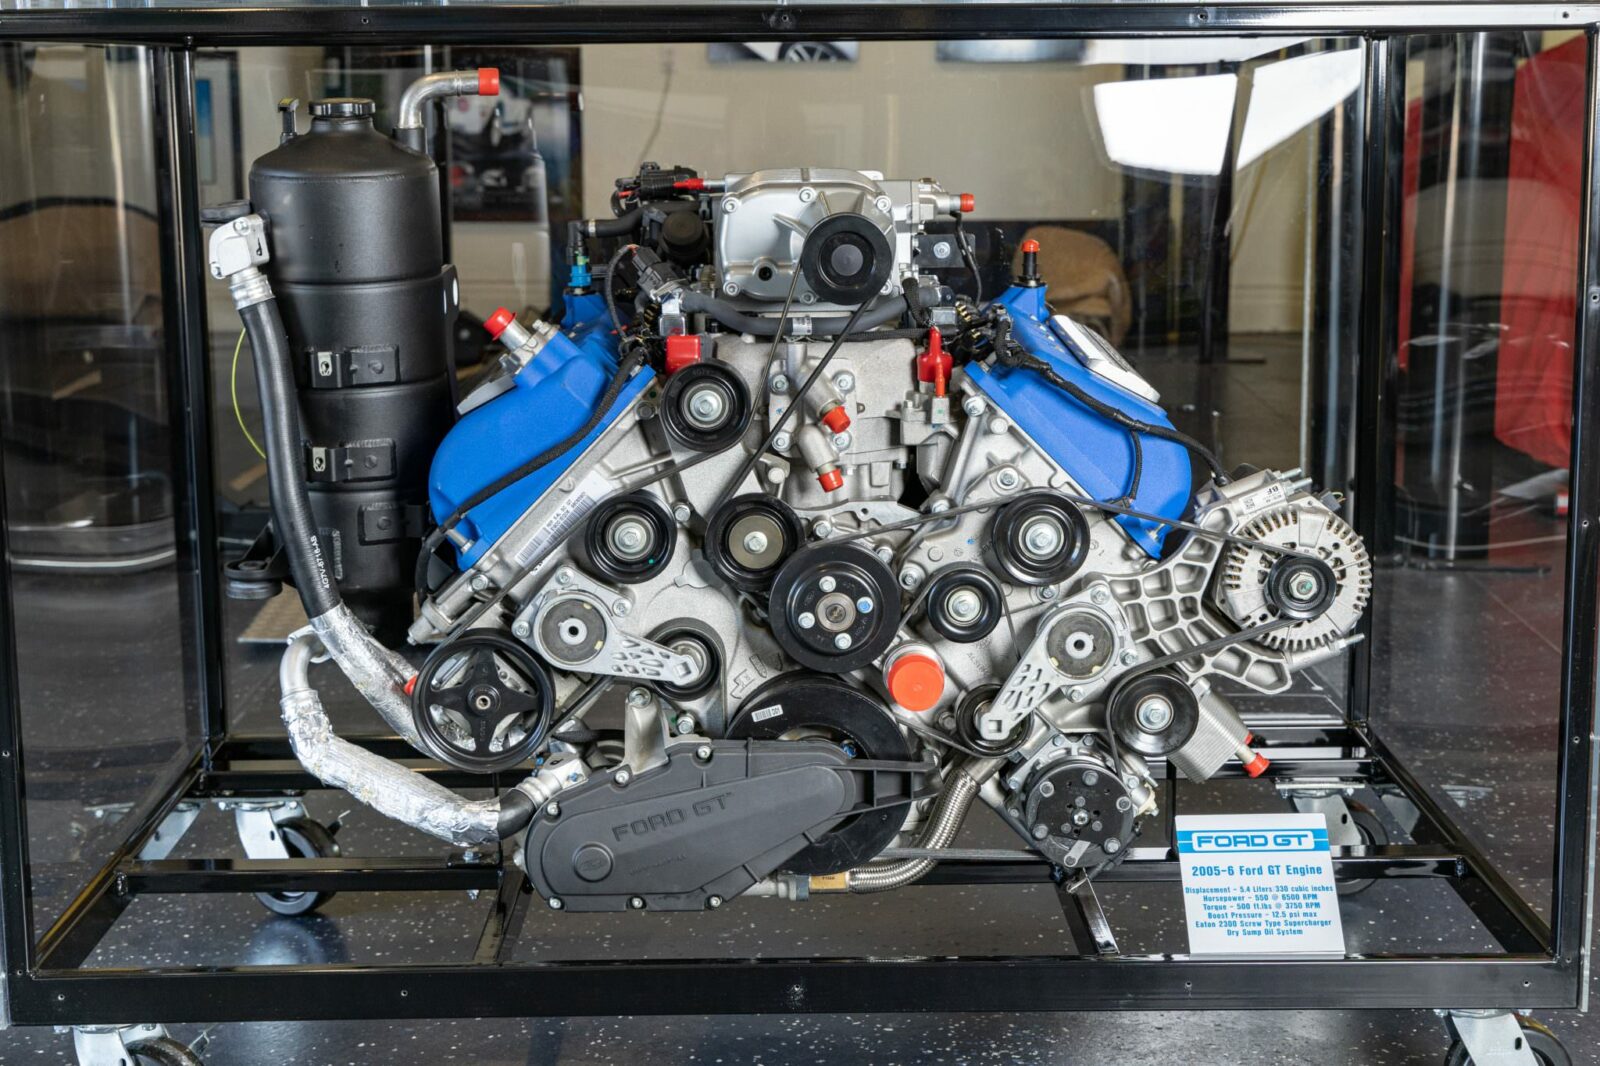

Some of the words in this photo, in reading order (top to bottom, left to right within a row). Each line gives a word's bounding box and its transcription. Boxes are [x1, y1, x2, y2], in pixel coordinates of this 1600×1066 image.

[612, 808, 685, 842] FORD
[1196, 834, 1269, 848] FORD
[1273, 834, 1309, 846] GT
[1191, 865, 1235, 877] 2005-6
[1239, 865, 1263, 876] Ford
[1268, 864, 1281, 875] GT
[1286, 864, 1323, 877] Engine
[1185, 886, 1231, 894] Displacement
[1240, 885, 1251, 893] 5.4
[1311, 884, 1334, 892] inches
[1203, 903, 1227, 911] Torque
[1231, 911, 1262, 919] Pressure
[1289, 910, 1300, 918] psi
[1219, 920, 1237, 928] 2300
[1284, 919, 1332, 927] Supercharger
[1242, 928, 1262, 936] Sump
[1276, 928, 1304, 936] System
